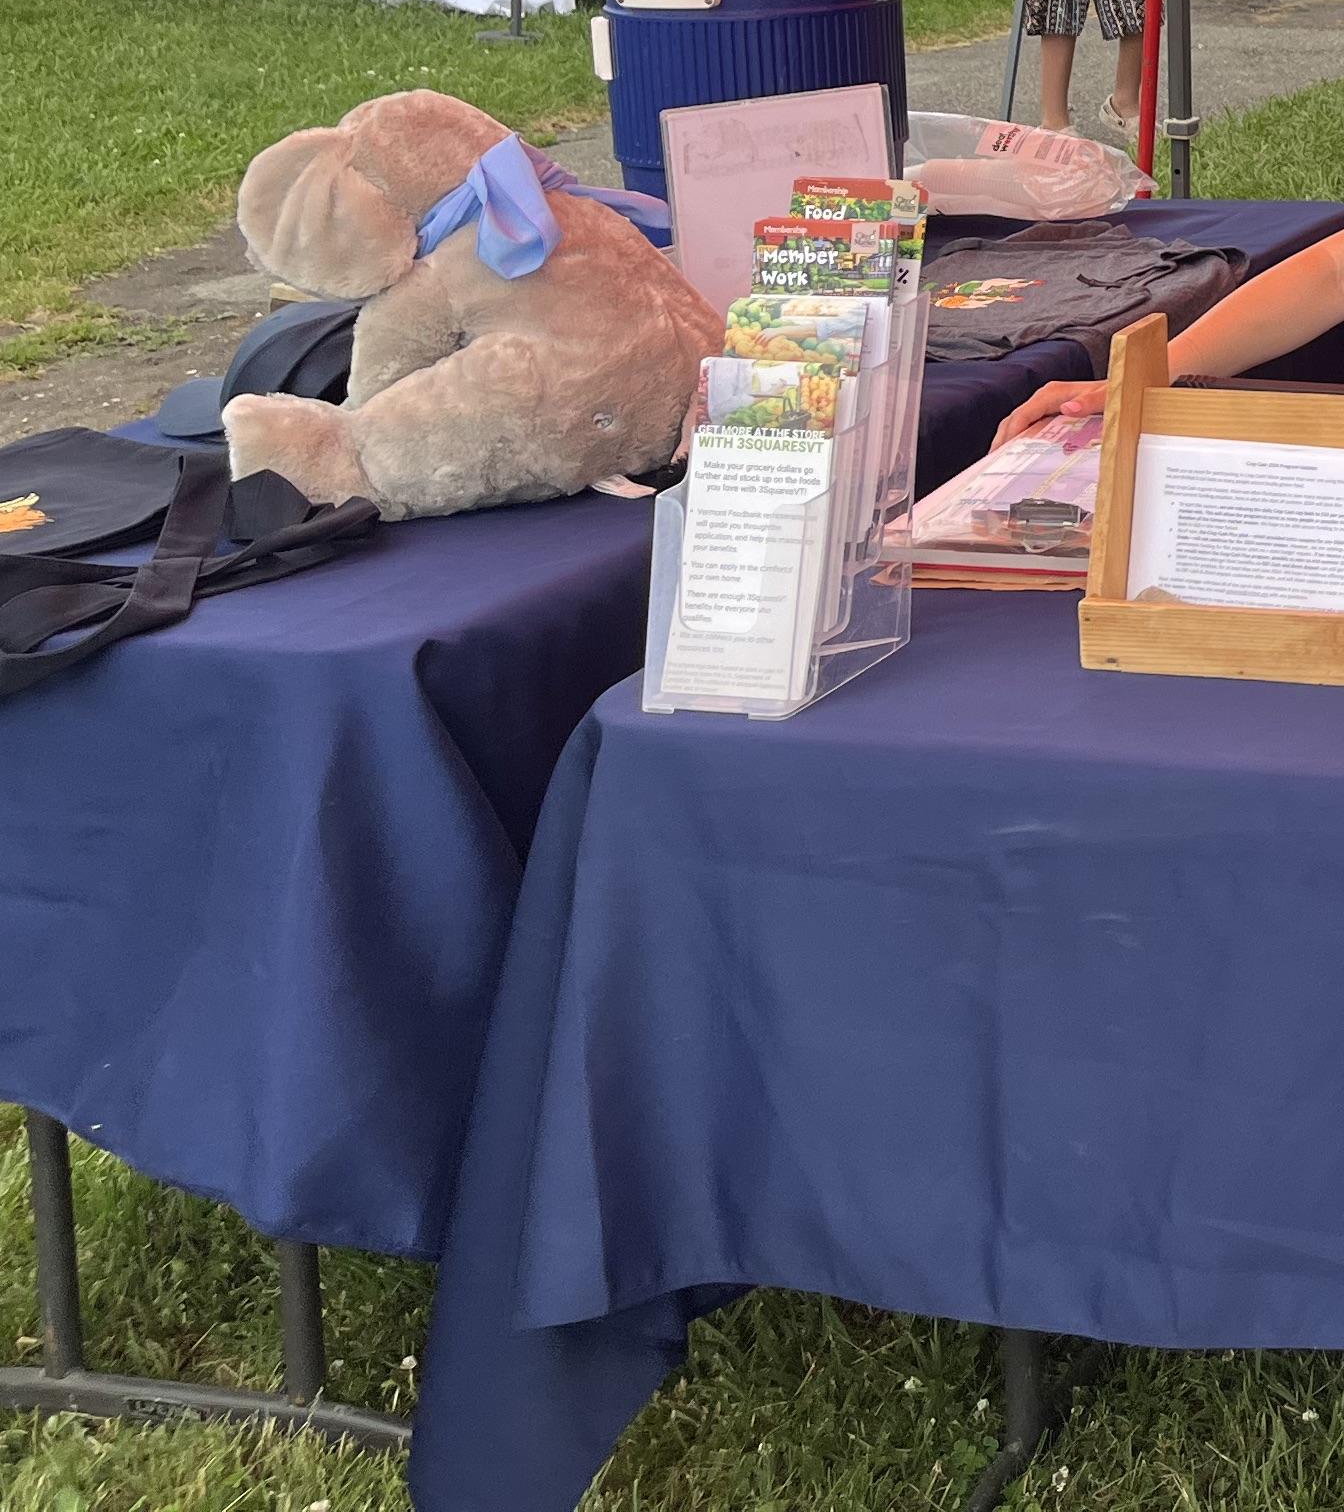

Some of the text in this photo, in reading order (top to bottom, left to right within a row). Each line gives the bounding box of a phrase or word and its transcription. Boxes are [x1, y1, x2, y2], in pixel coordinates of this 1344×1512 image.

[807, 184, 849, 196] Membership
[804, 205, 847, 221] Food
[763, 225, 808, 236] Membership
[762, 246, 839, 265] Member
[760, 270, 809, 286] Work
[698, 424, 826, 440] GET MORE AT THE STORE
[698, 436, 825, 454] WITH 3SQUARESVT
[703, 460, 814, 475] Make your grocery dollars go
[694, 471, 821, 486] further and stock up on the foods
[706, 485, 721, 493] you
[722, 484, 739, 493] love
[740, 485, 757, 494] with
[691, 561, 704, 569] You
[719, 563, 738, 572] apply
